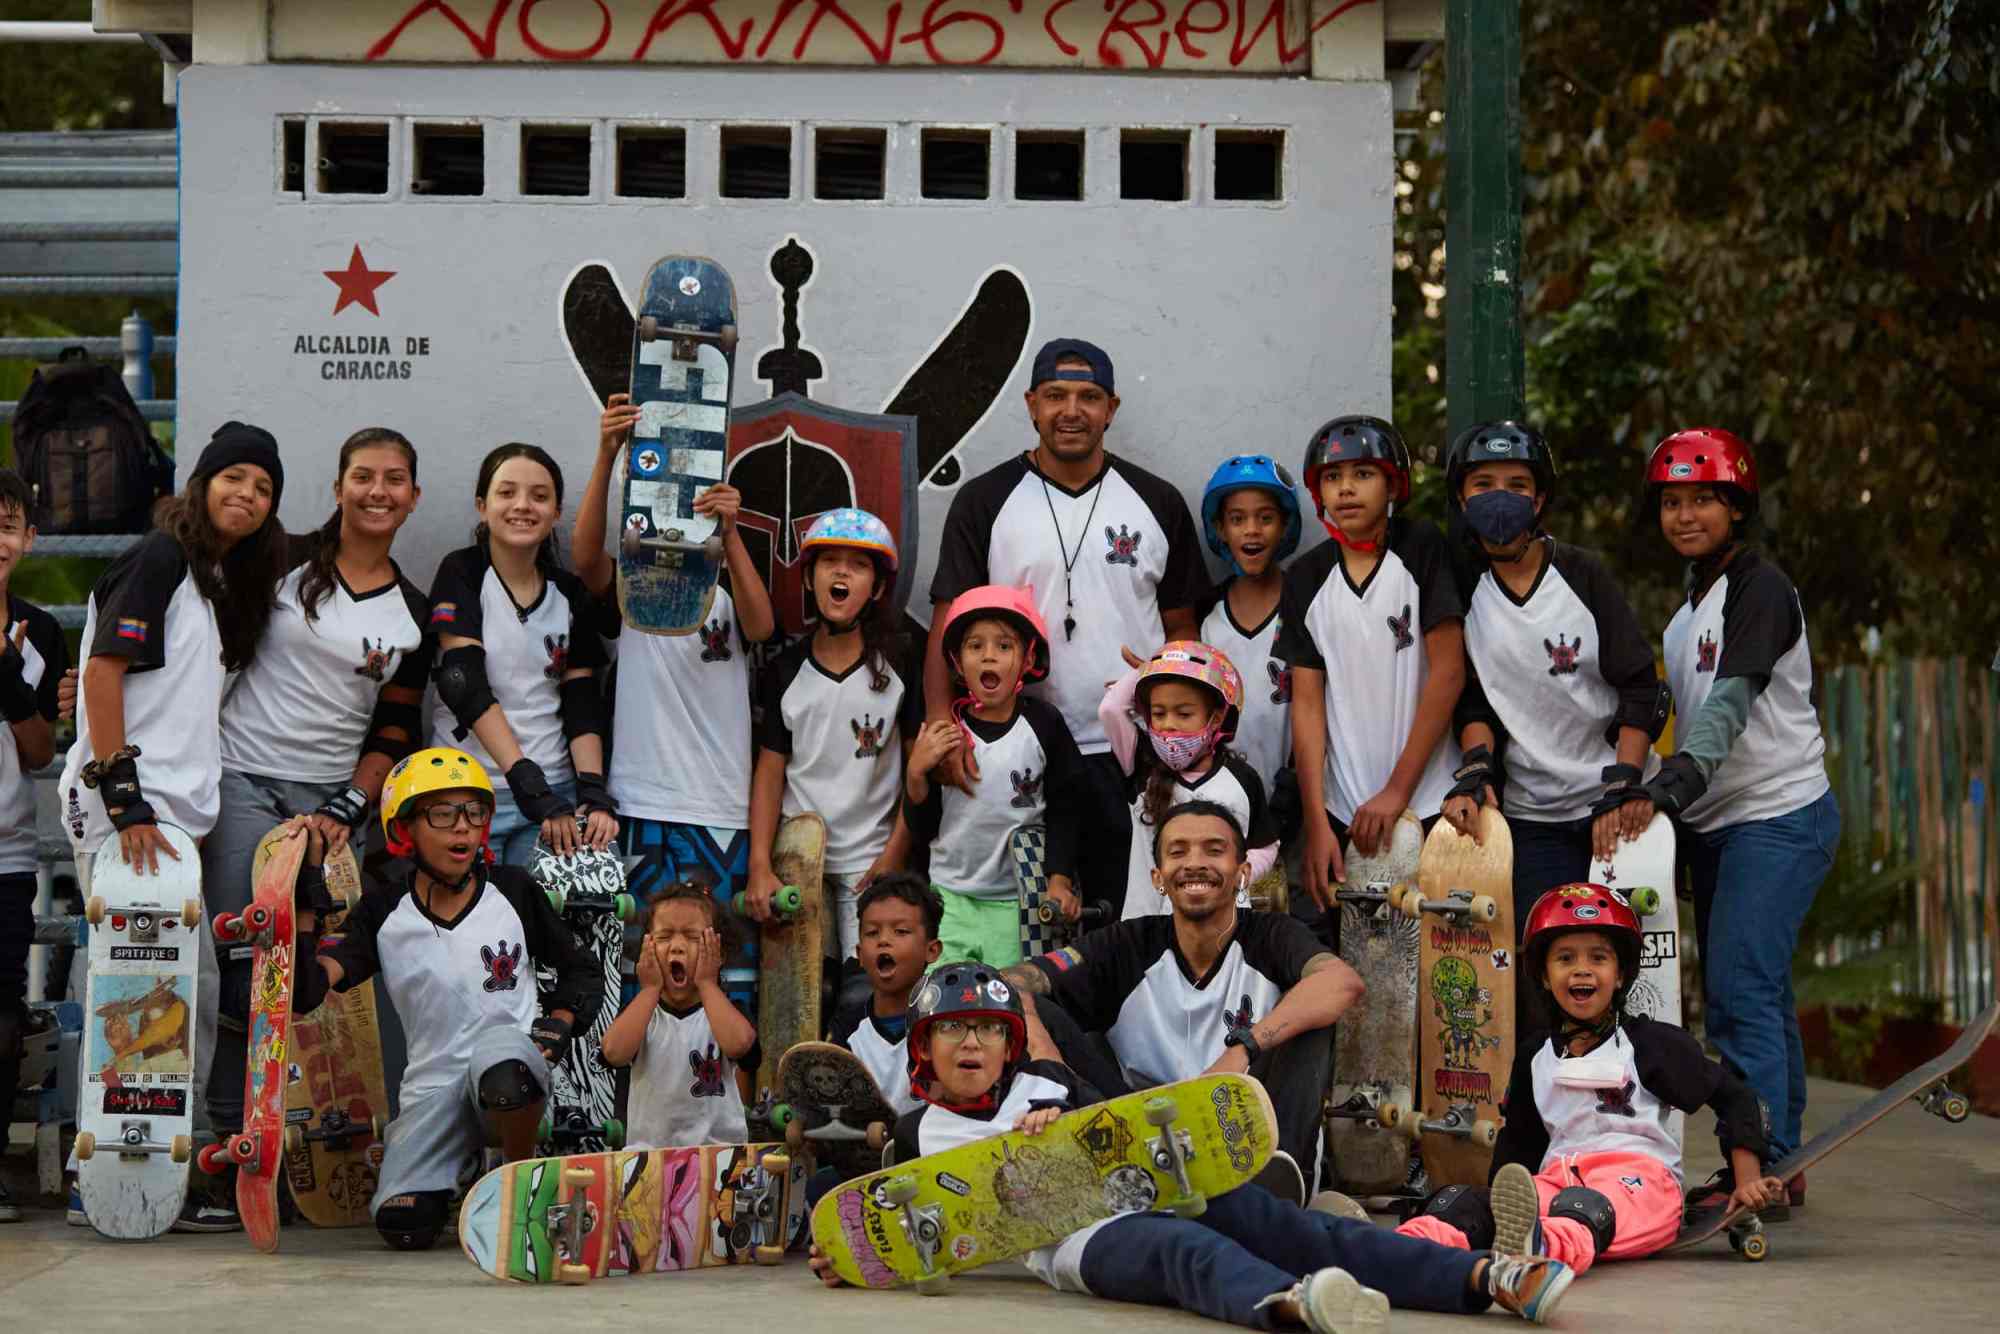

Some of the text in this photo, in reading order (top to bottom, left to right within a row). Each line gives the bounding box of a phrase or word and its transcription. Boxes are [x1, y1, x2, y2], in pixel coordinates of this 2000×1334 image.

[294, 335, 430, 356] ALCALDIA DE
[321, 360, 412, 380] CARACAS
[114, 947, 166, 960] SPITFIRE
